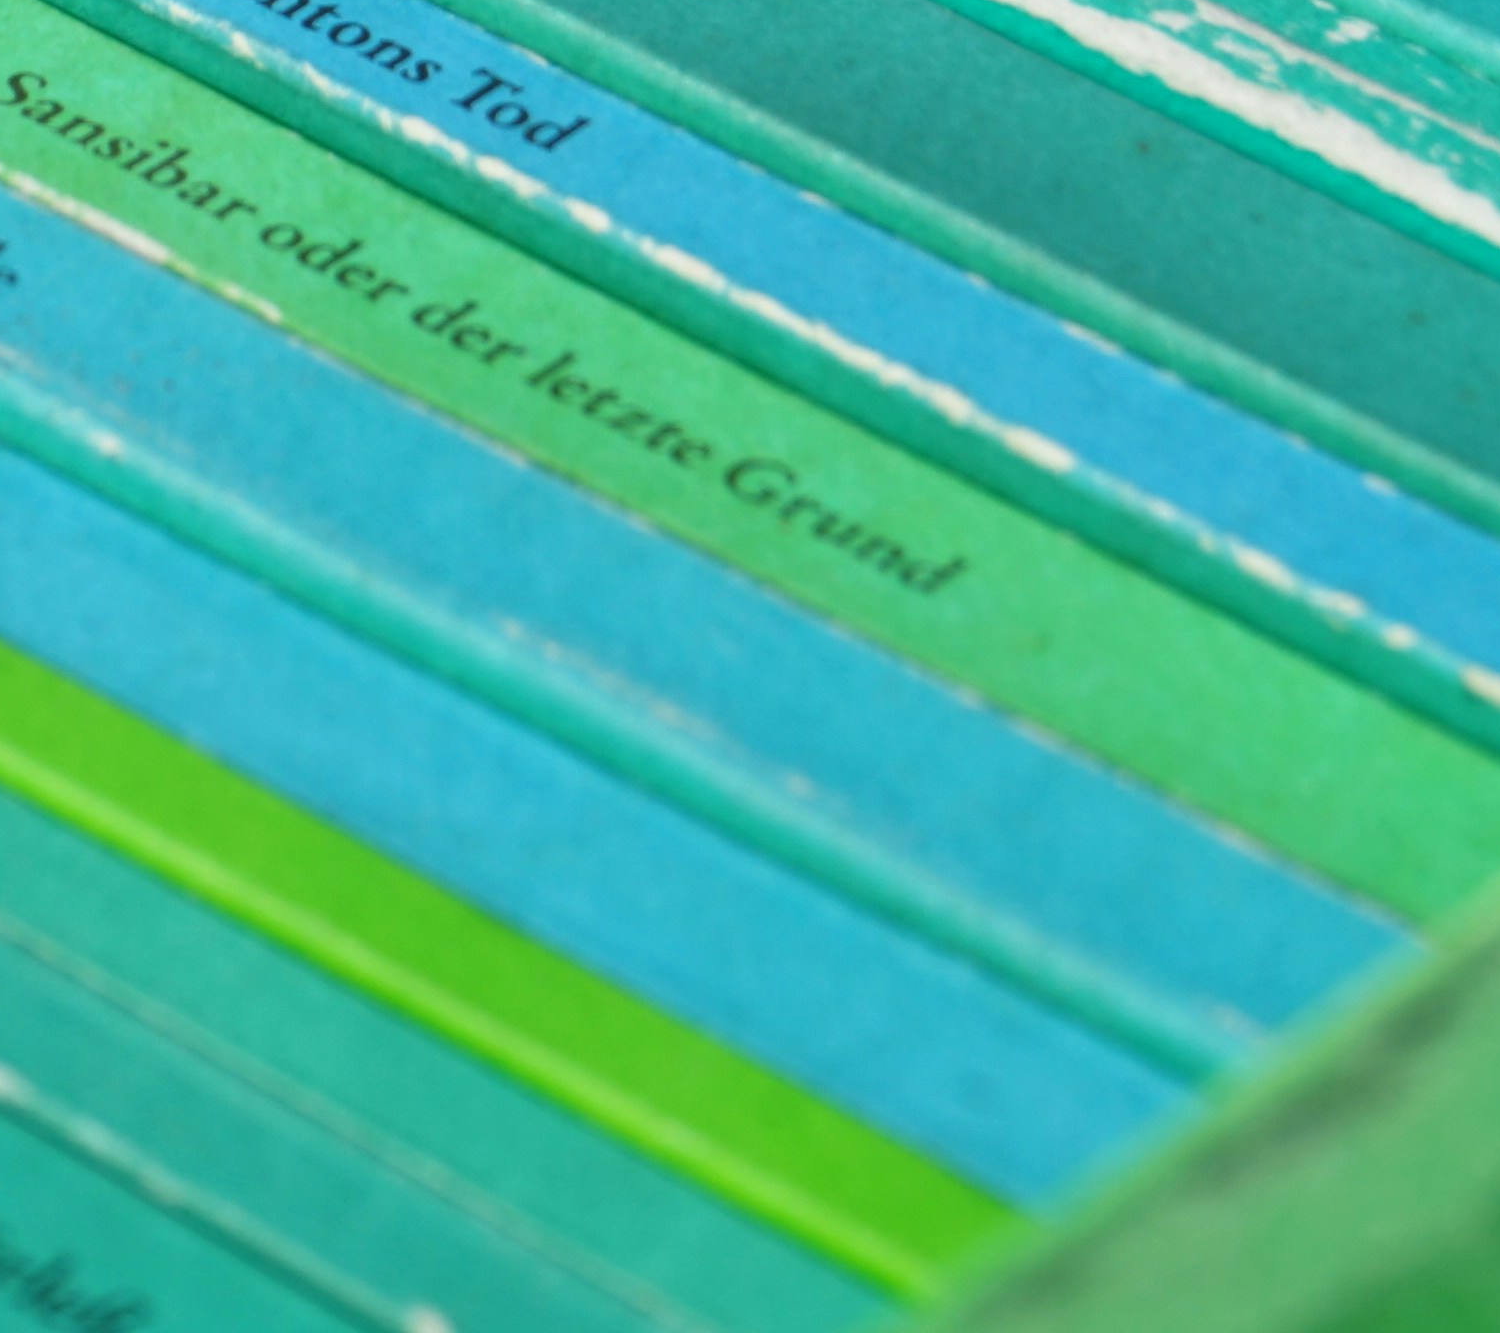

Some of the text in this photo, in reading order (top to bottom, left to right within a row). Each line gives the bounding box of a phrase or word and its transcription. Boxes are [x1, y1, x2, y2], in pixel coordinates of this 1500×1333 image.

[450, 65, 594, 155] Tod
[258, 221, 413, 307] oder
[408, 299, 532, 371] der
[524, 349, 715, 472] letzte
[720, 454, 970, 597] Grund
